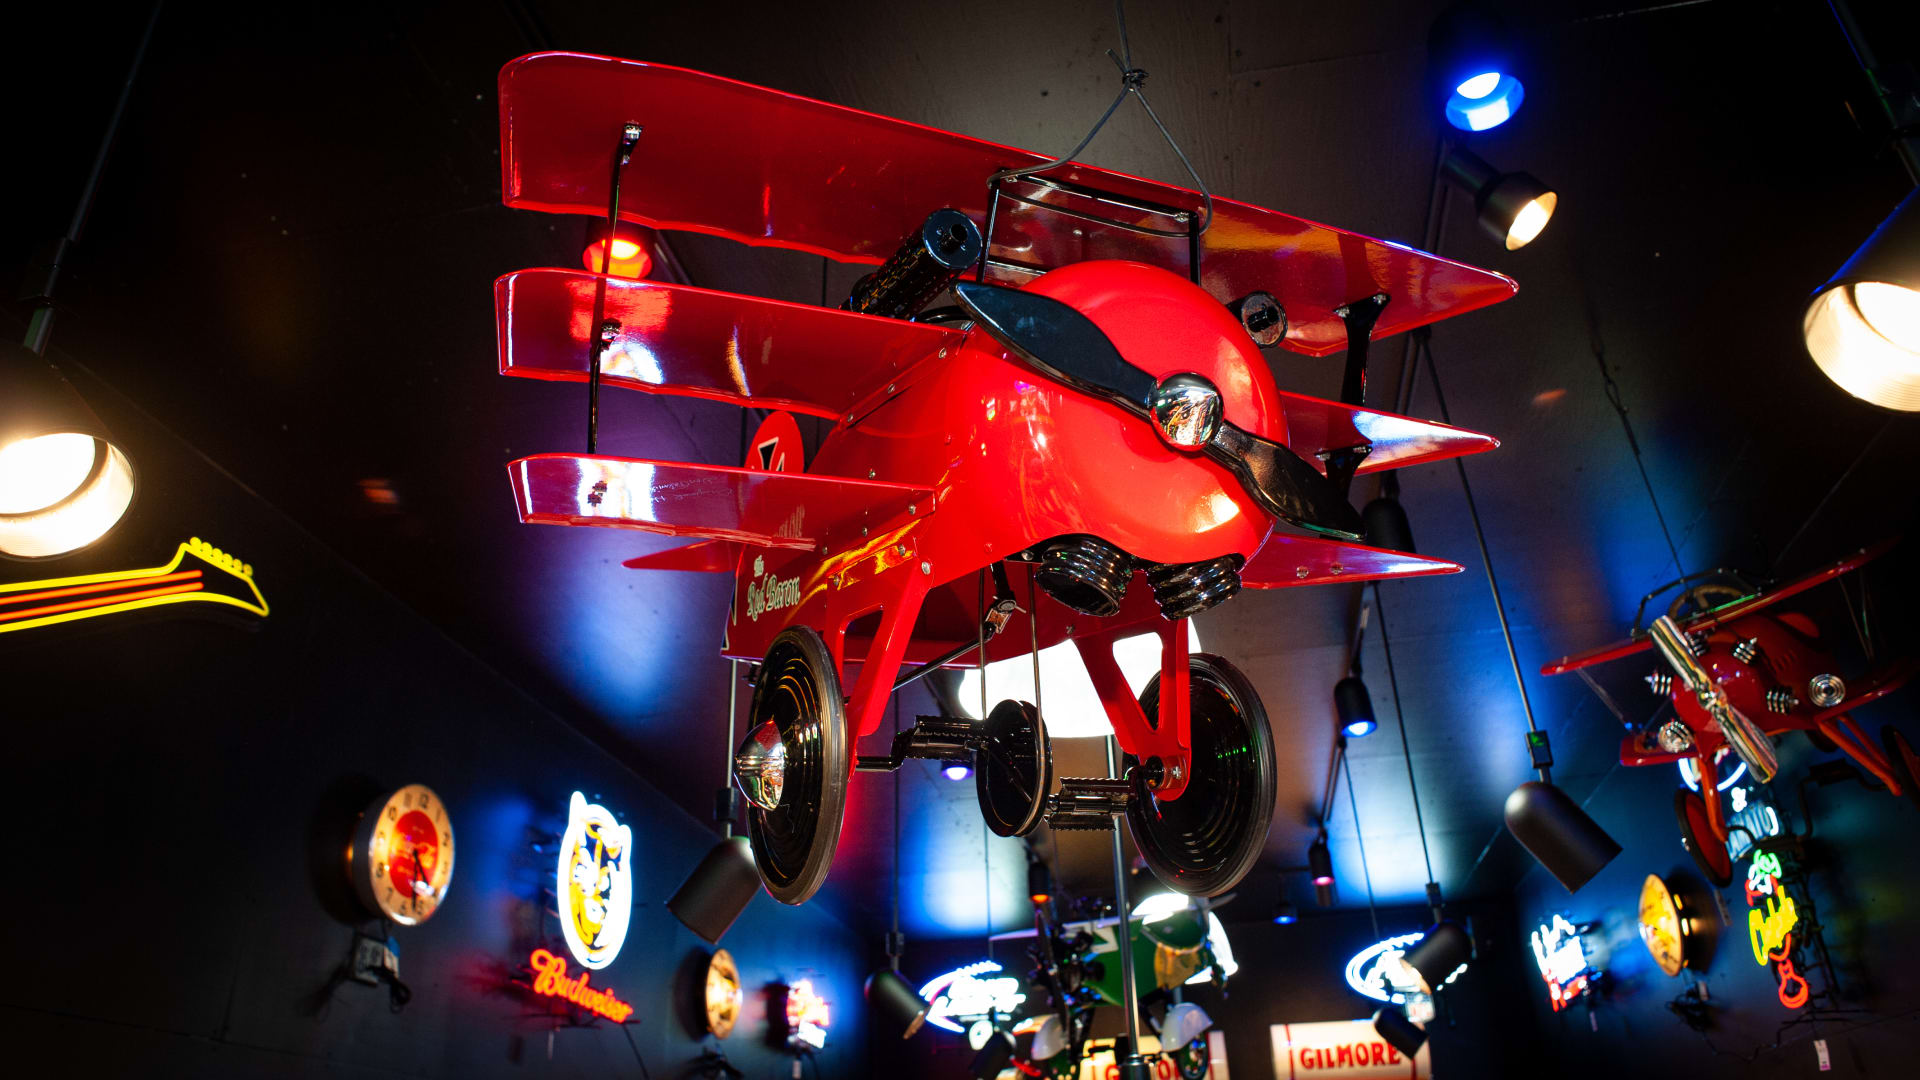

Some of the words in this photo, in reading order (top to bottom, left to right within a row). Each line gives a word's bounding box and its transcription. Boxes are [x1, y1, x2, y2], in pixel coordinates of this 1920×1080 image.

[747, 573, 768, 622] Red
[766, 574, 801, 611] Baron
[530, 949, 633, 1024] Budweiser
[1300, 1042, 1401, 1069] GILMORE
